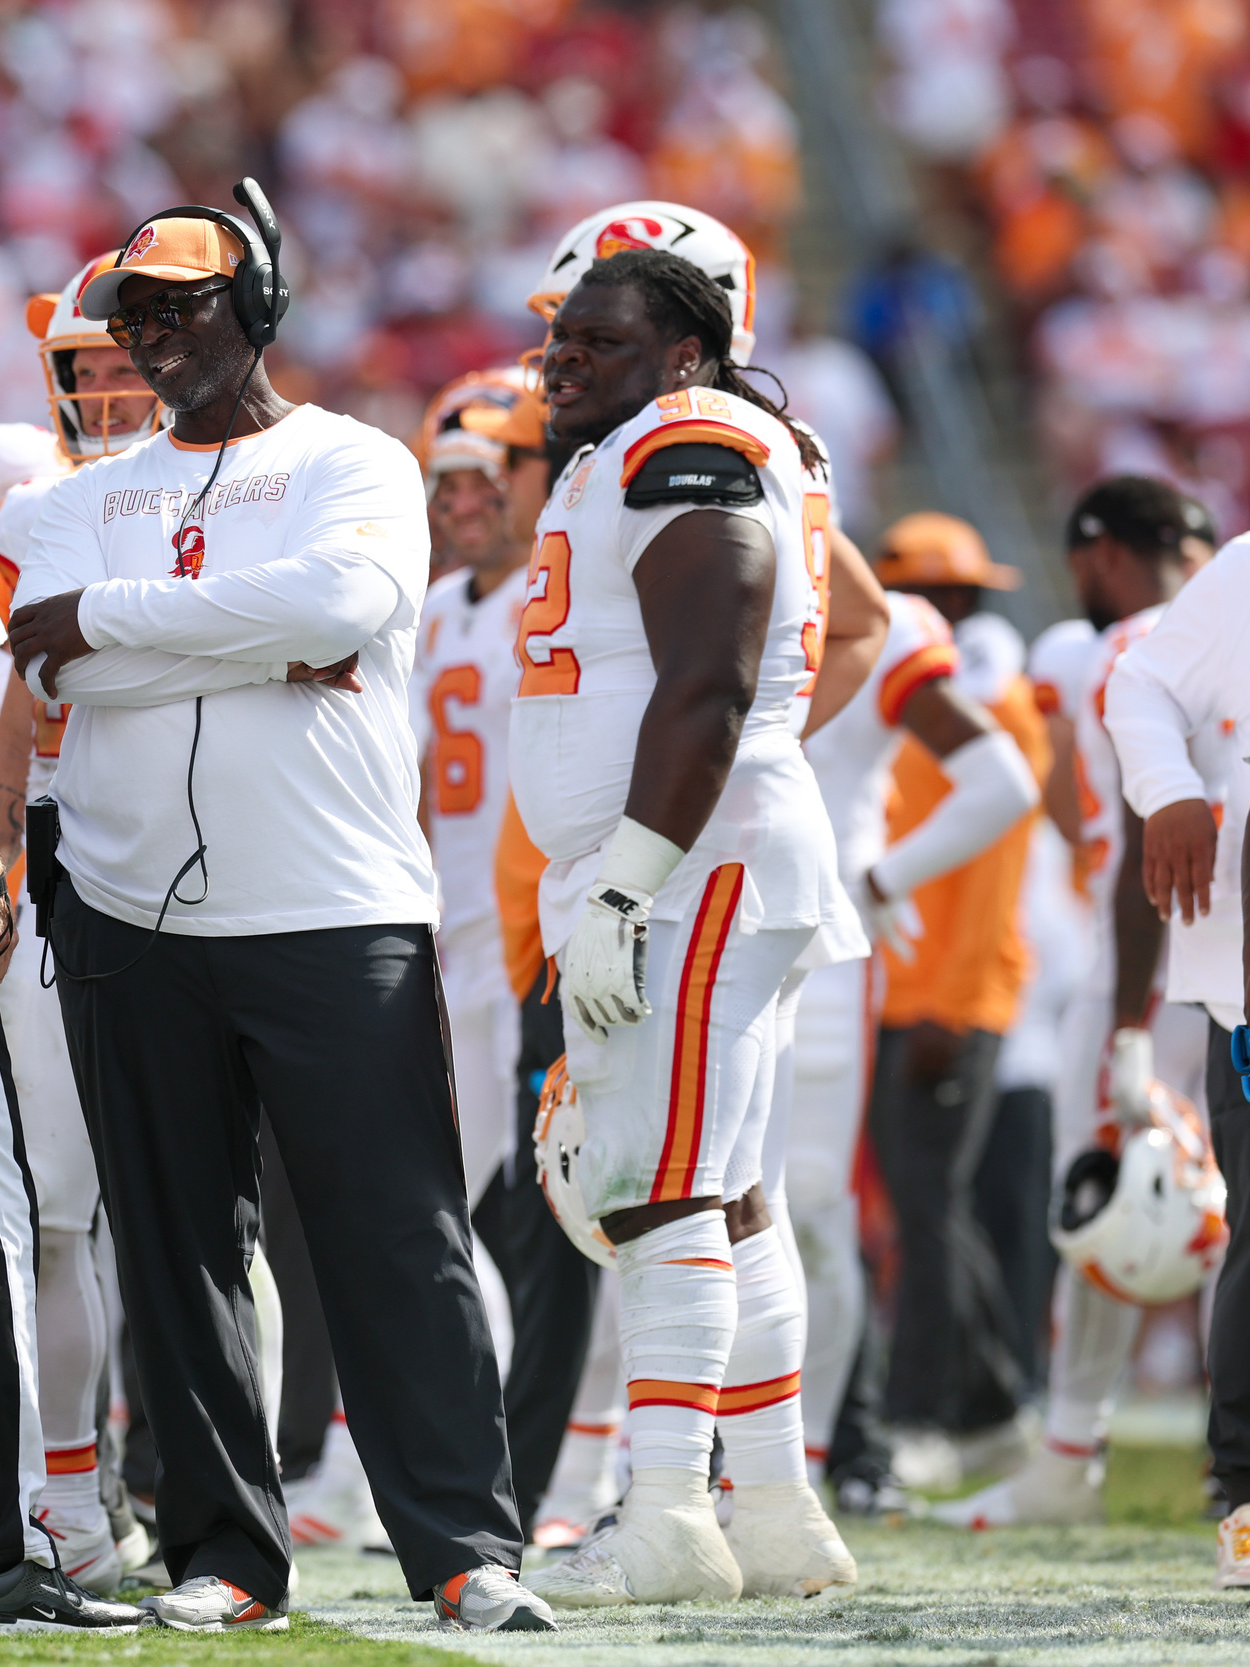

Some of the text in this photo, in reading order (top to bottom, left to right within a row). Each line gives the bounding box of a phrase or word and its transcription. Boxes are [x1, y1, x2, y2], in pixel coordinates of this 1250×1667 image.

[252, 190, 276, 230] SONY
[655, 387, 732, 423] 92
[513, 530, 581, 698] 2
[429, 664, 485, 817] 6
[598, 888, 640, 916] NIKE
